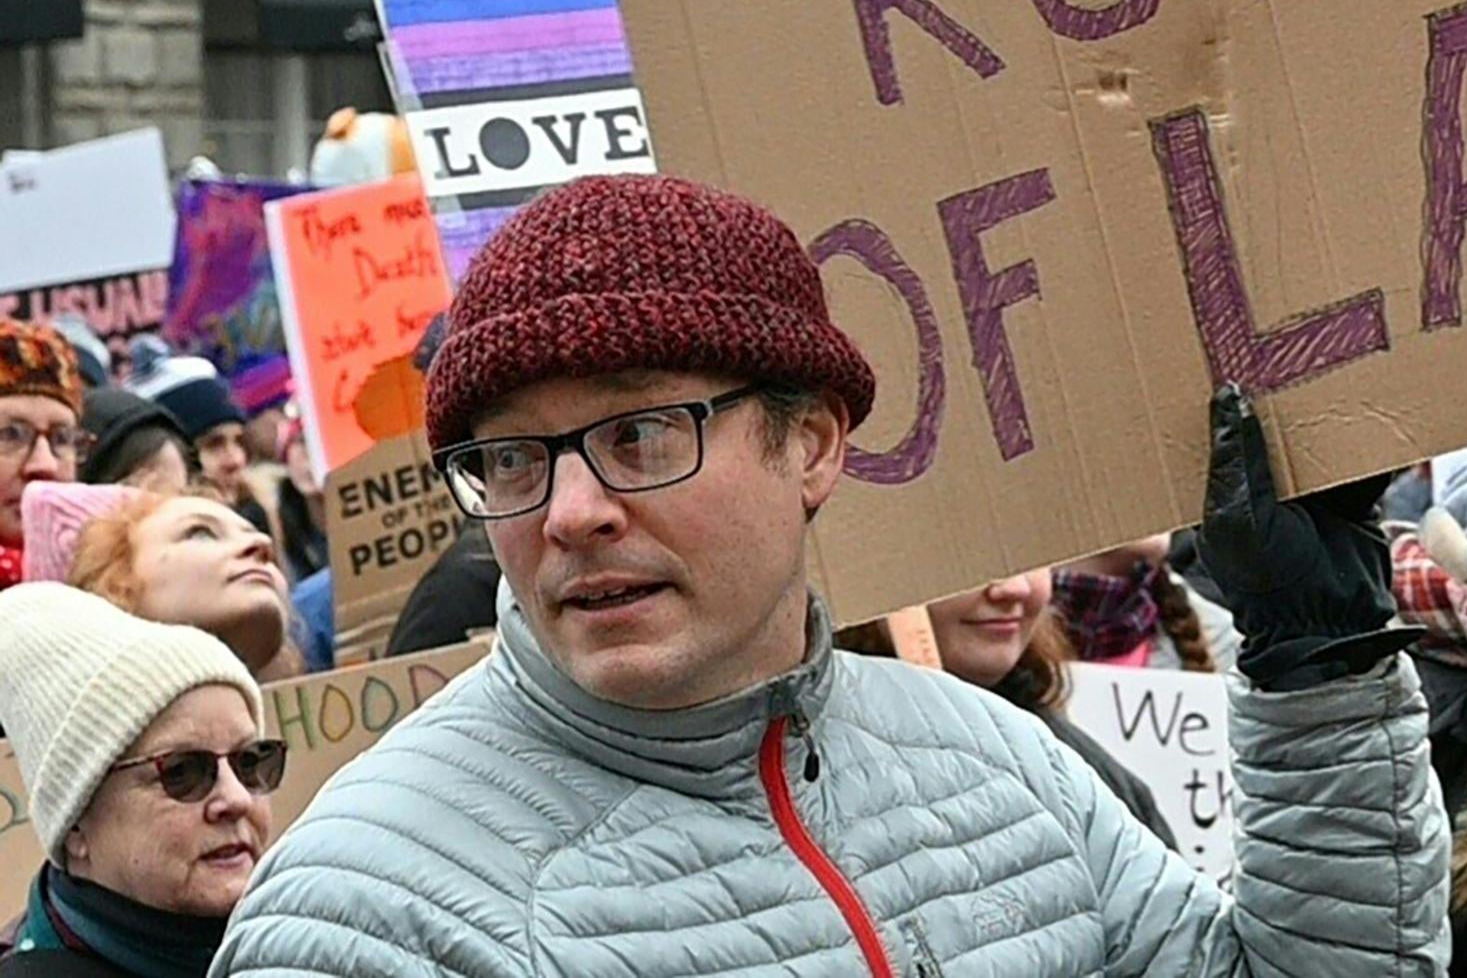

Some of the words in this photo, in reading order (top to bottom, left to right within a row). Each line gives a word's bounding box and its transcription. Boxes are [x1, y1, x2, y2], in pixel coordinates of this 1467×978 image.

[423, 105, 651, 180] LOVE
[806, 167, 1058, 485] OF
[348, 513, 460, 577] PEOP
[1112, 681, 1216, 757] We
